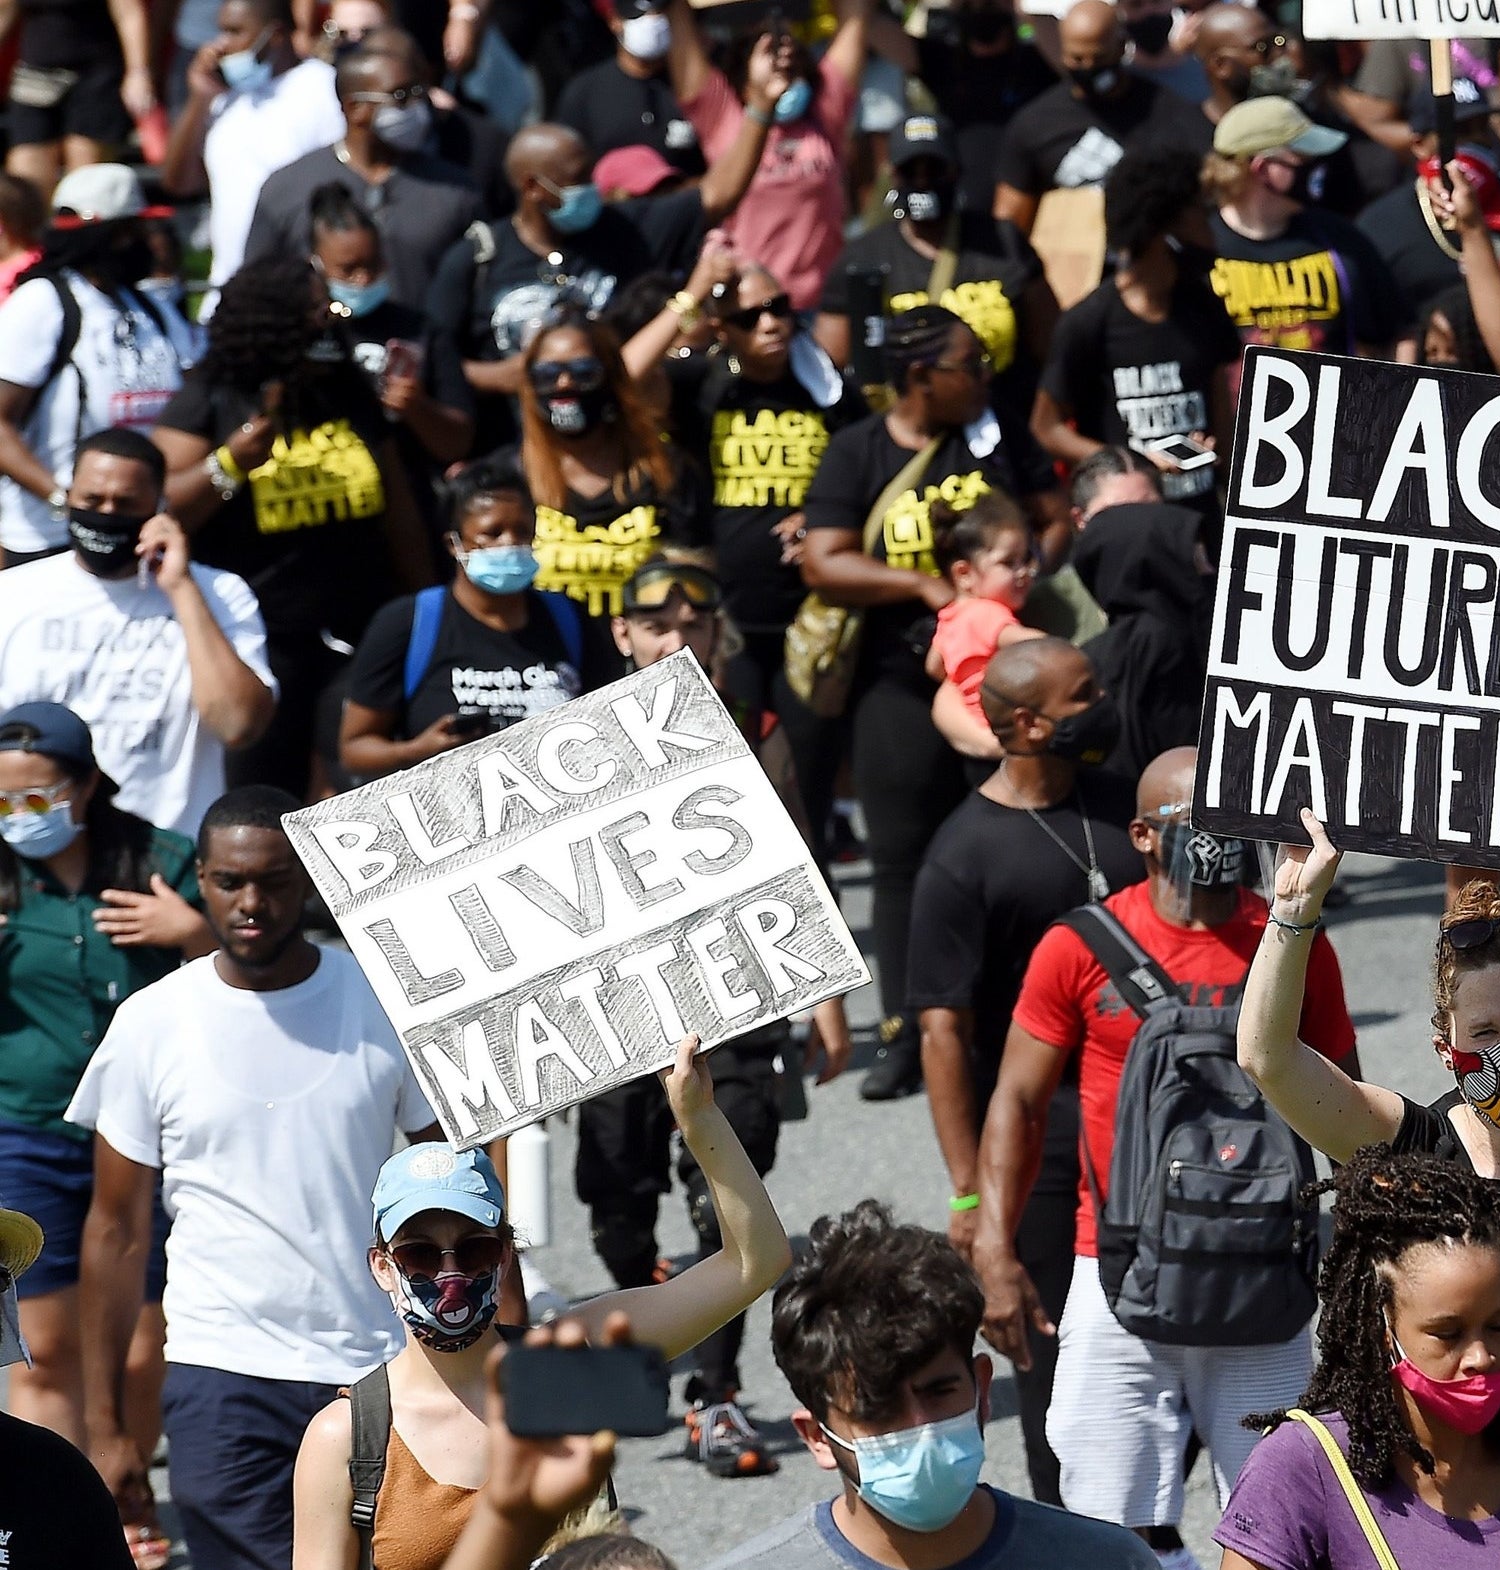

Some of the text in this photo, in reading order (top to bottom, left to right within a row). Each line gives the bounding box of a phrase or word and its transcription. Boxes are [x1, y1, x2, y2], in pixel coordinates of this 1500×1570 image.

[312, 675, 723, 897] BLACK
[363, 784, 753, 1007] LIVES
[418, 897, 827, 1140] MATTER
